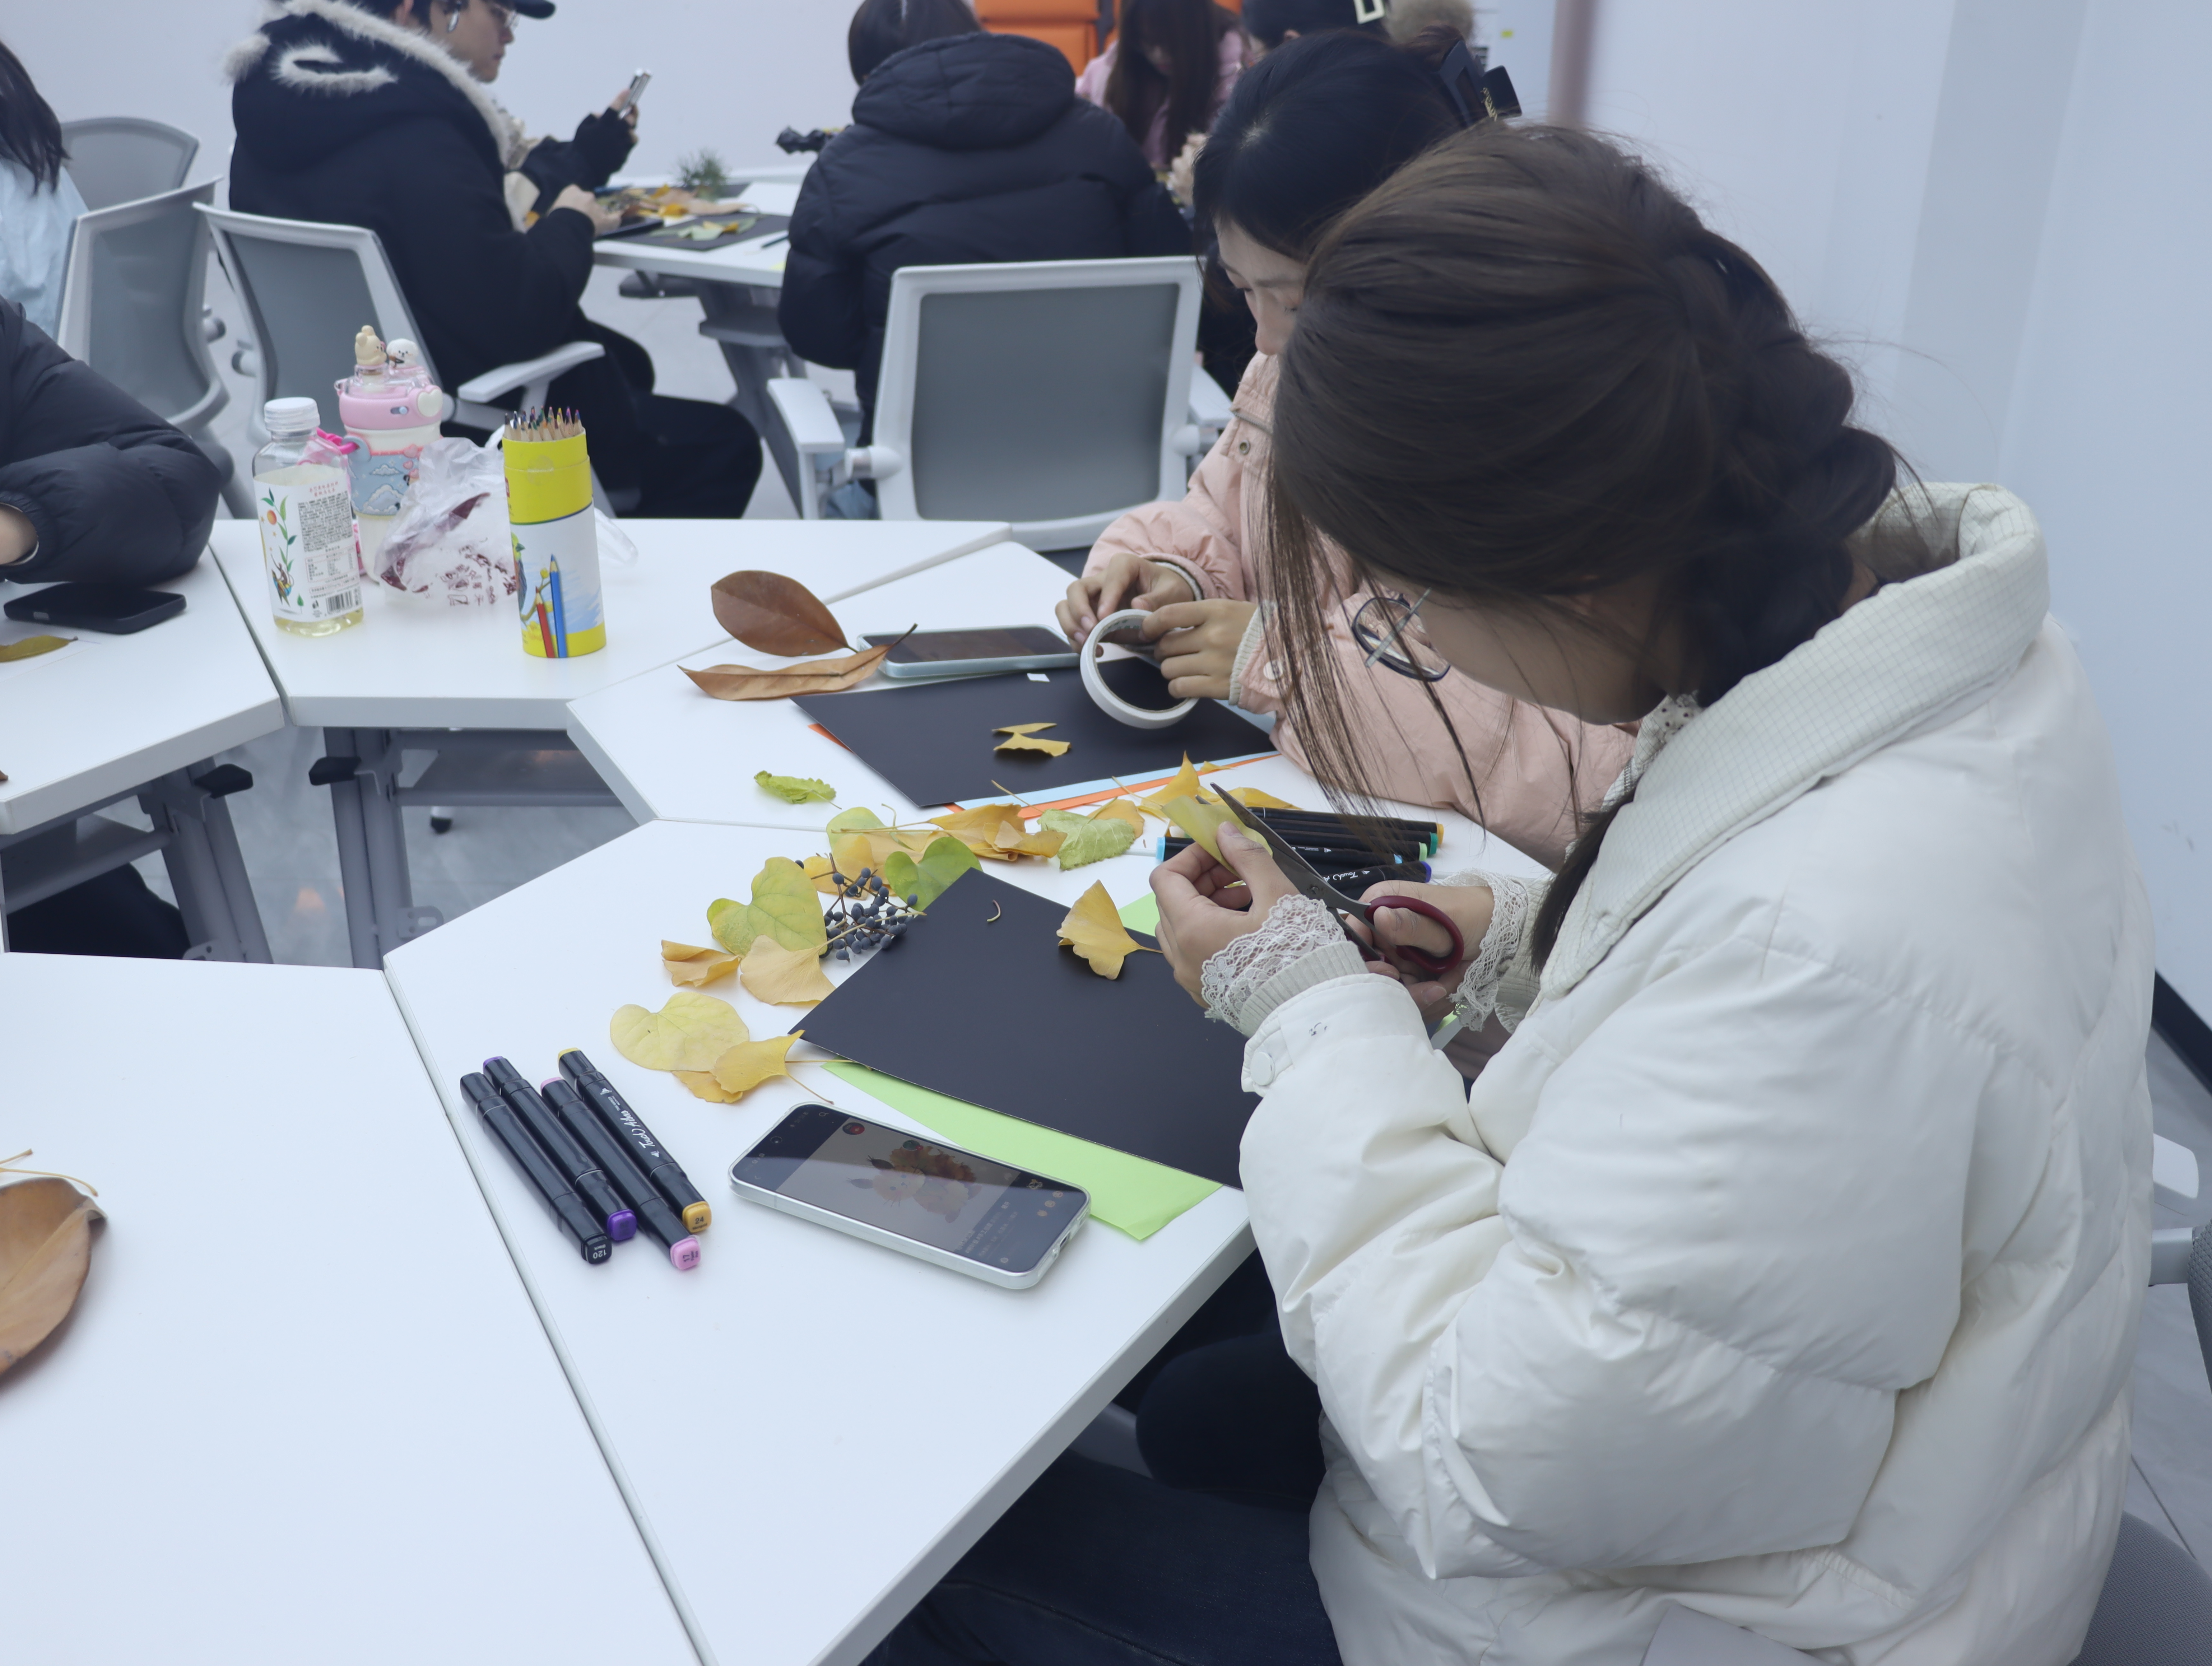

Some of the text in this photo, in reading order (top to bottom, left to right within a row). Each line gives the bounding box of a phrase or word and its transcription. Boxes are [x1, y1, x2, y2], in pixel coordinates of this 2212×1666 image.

[1333, 871, 1358, 880] Touch
[631, 1128, 655, 1148] Touch
[695, 1216, 704, 1224] 24
[593, 1249, 607, 1259] 120
